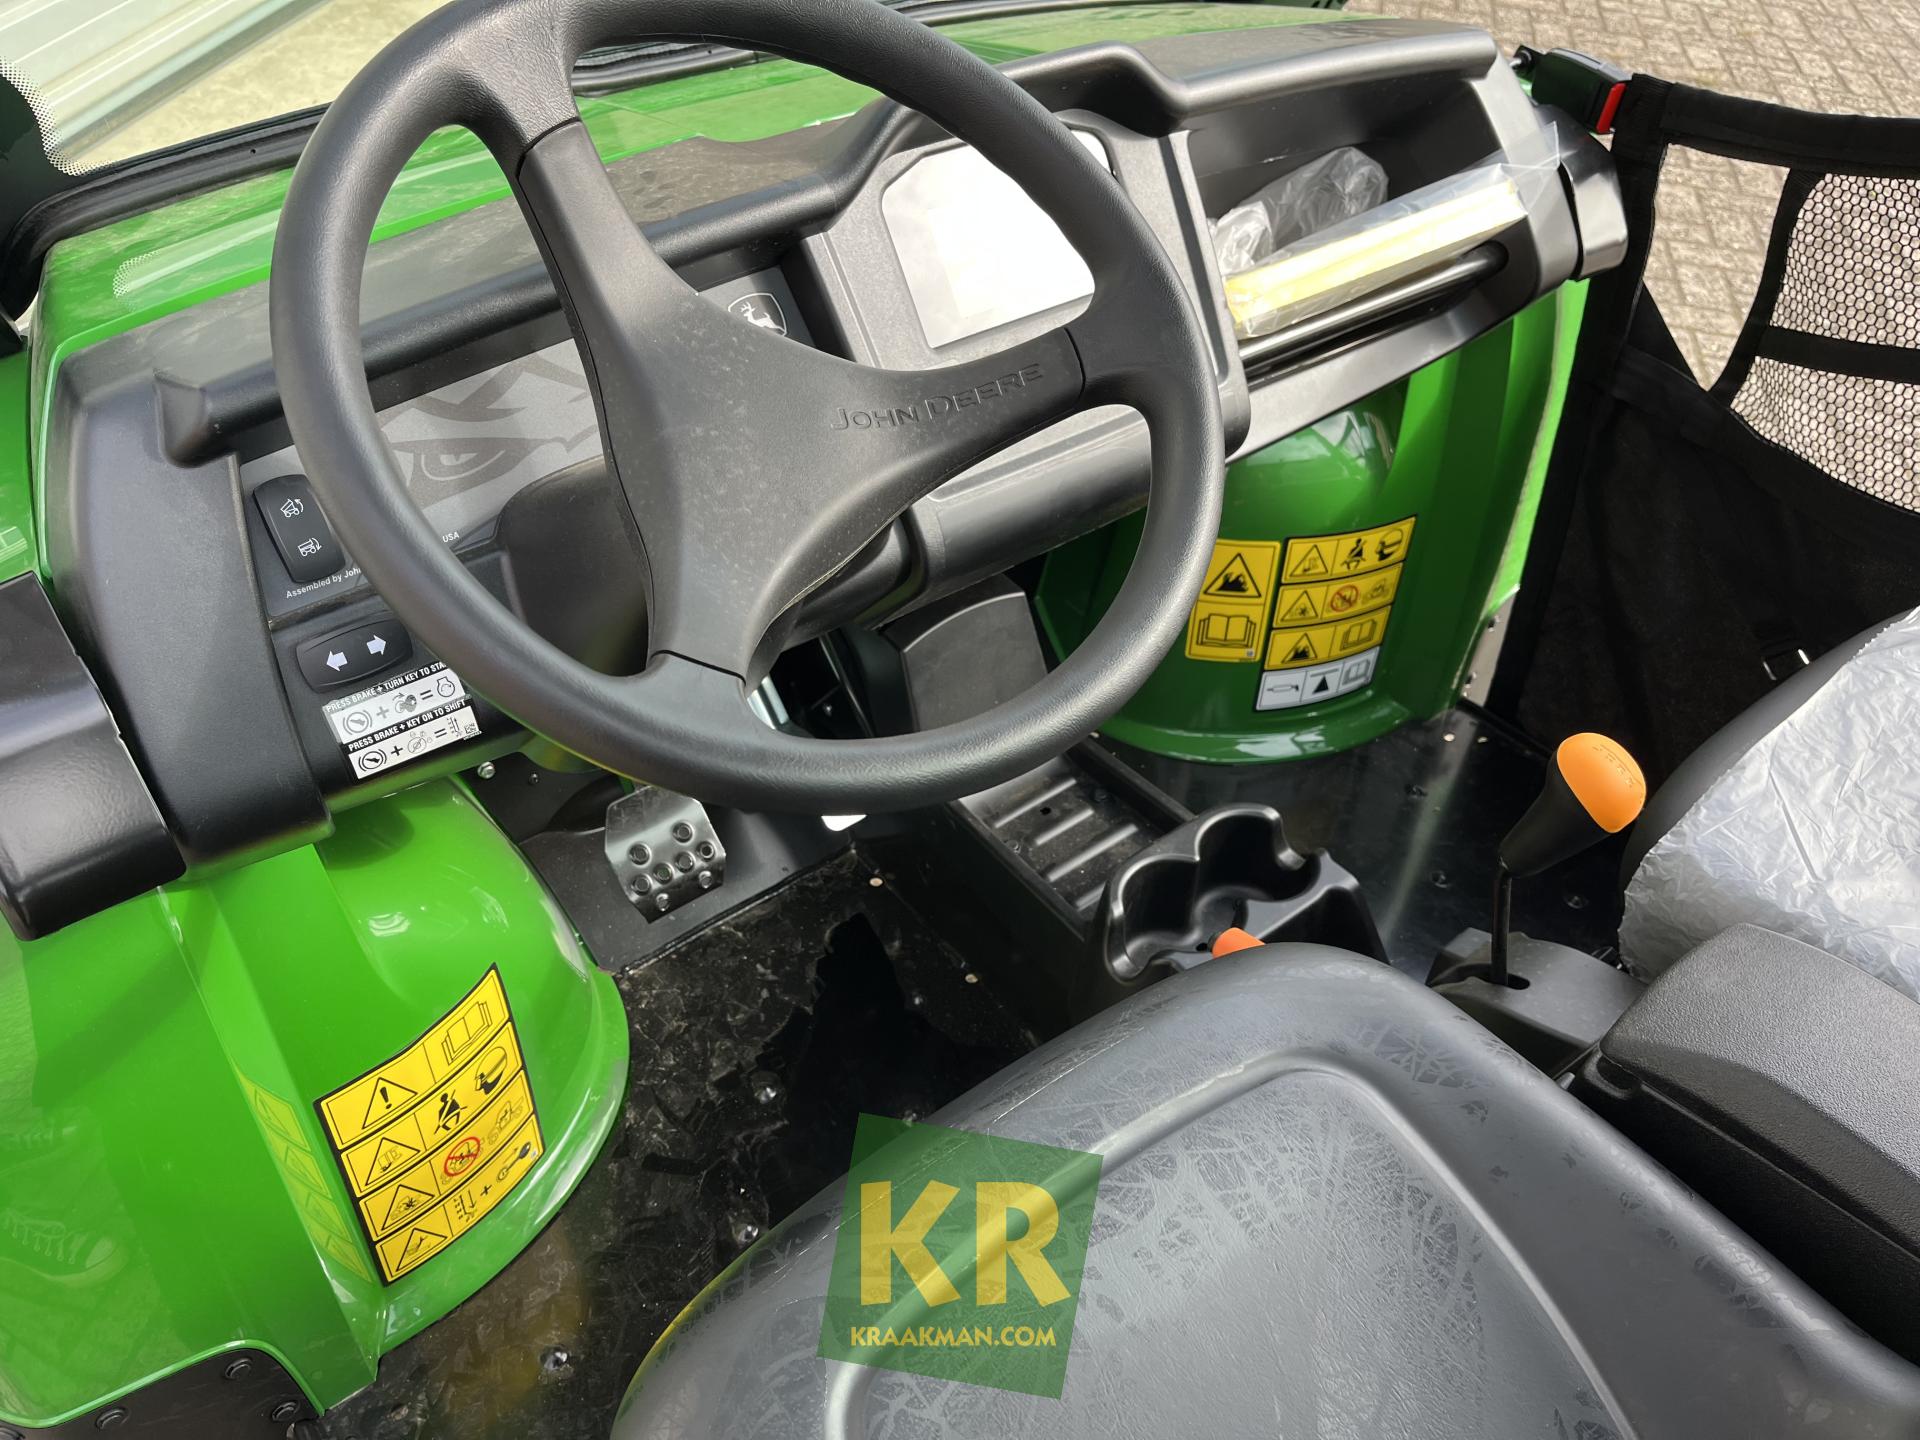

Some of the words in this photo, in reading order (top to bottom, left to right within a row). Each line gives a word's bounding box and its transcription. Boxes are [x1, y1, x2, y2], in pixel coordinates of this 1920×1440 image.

[830, 405, 920, 431] JOHN
[924, 363, 1044, 420] DEERE
[286, 577, 331, 599] Assembled
[332, 574, 342, 583] by
[442, 531, 460, 543] USA
[326, 699, 351, 713] PRESS
[352, 688, 376, 705] BRAKE
[384, 677, 404, 690] TURN
[405, 671, 419, 682] KEY
[419, 666, 430, 677] TO
[430, 661, 447, 673] STA
[348, 738, 374, 752] PRESS
[374, 728, 400, 742] BRAKE
[406, 717, 421, 729] KEY
[422, 711, 434, 723] ON
[434, 707, 444, 718] TO
[444, 699, 466, 714] SHIFT
